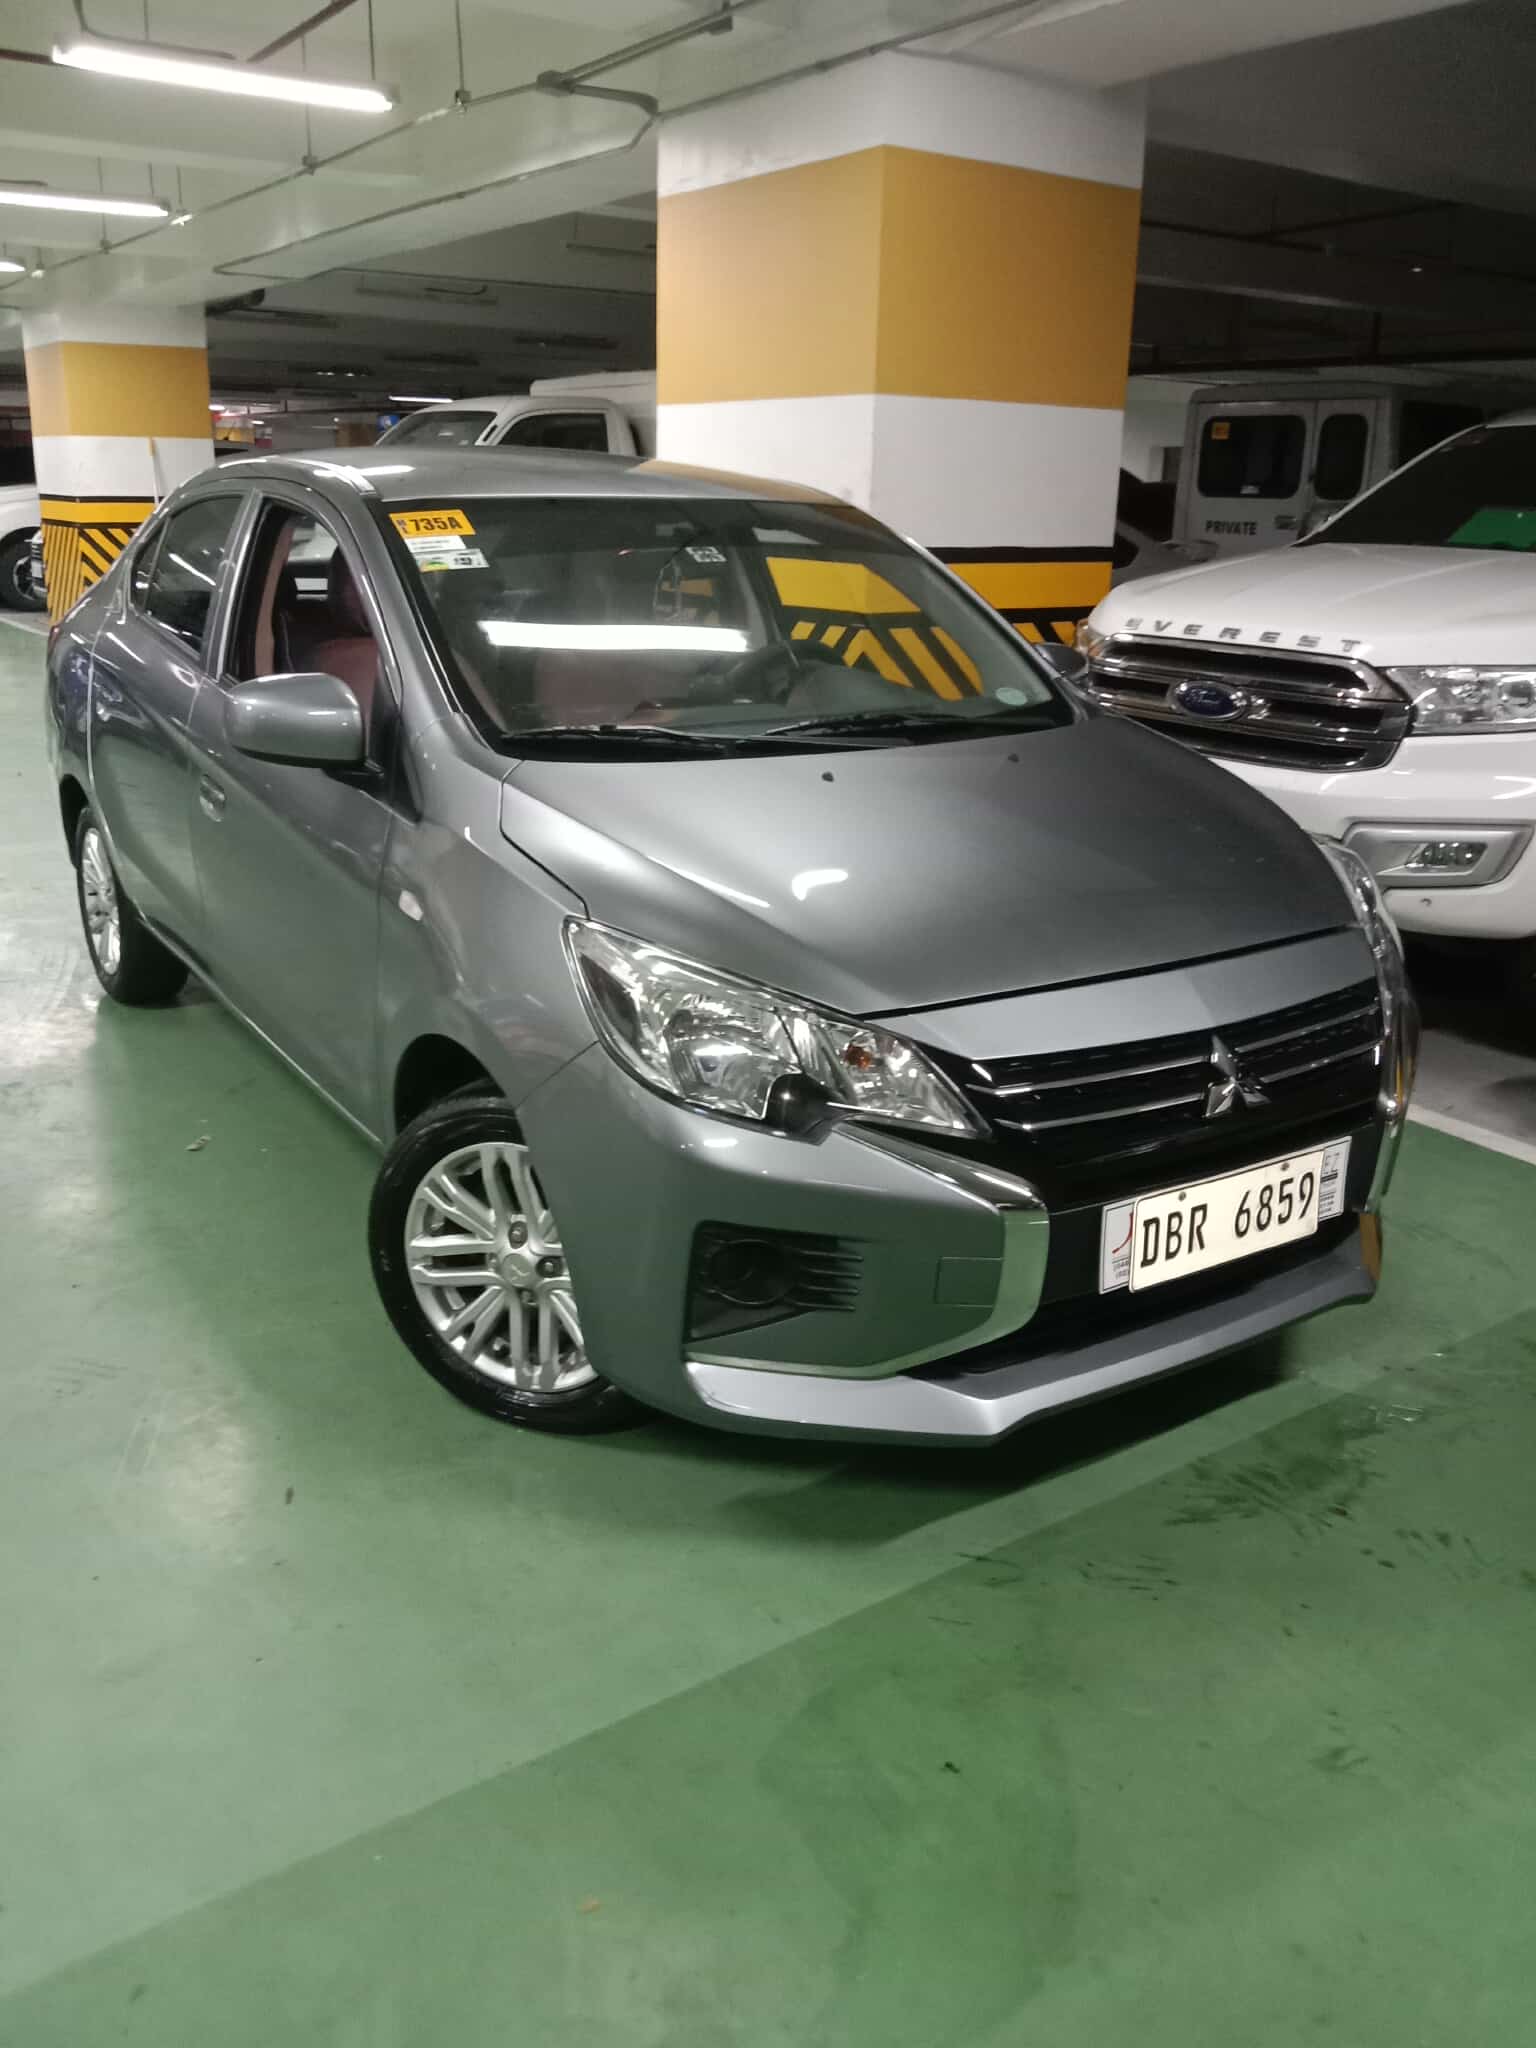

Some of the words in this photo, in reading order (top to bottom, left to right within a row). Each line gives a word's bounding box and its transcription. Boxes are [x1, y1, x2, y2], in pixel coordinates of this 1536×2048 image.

[407, 516, 463, 532] 735A
[1205, 519, 1258, 536] PRIVATE
[1125, 617, 1362, 653] EVEREST
[1140, 1203, 1209, 1269] DBR
[1234, 1171, 1315, 1239] 6859
